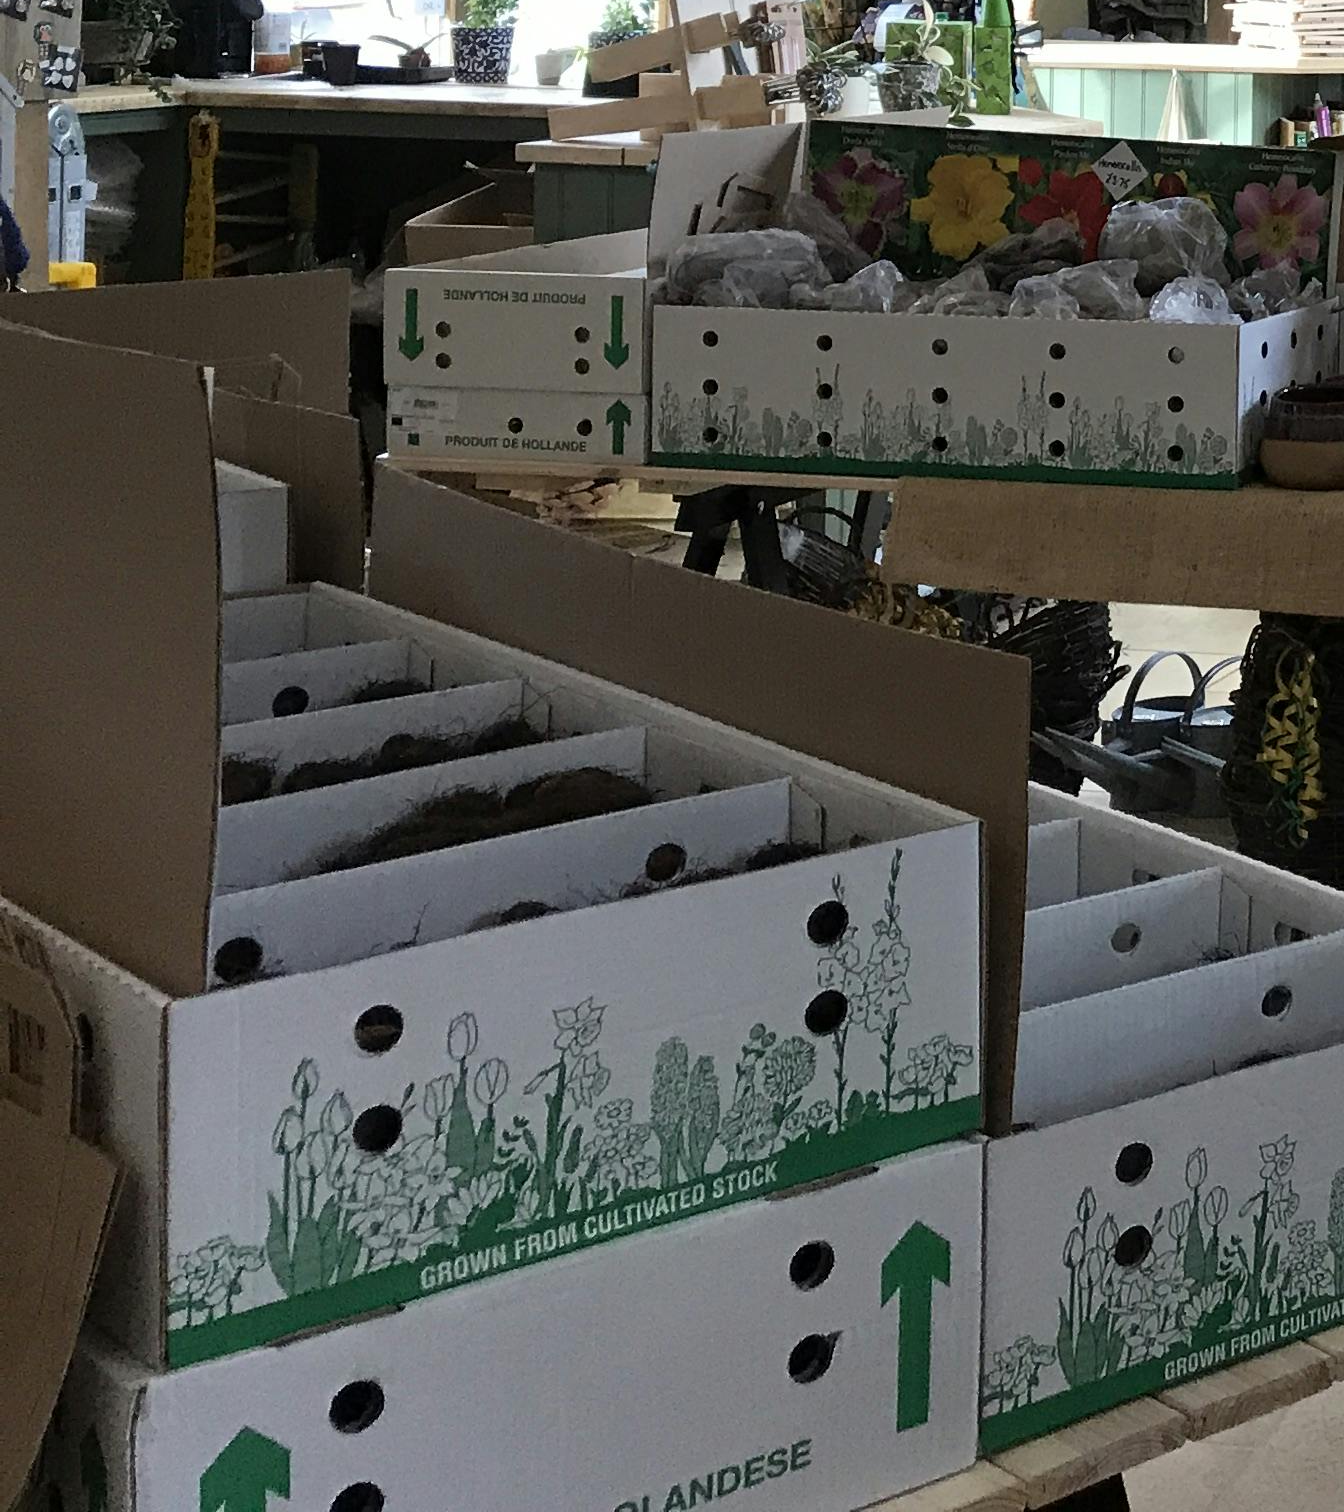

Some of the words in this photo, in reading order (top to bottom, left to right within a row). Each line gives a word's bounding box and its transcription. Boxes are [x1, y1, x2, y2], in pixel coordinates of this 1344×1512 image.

[443, 288, 508, 304] HOLLANDE
[511, 291, 529, 303] DE
[531, 292, 587, 305] PRODUIT
[445, 435, 499, 448] PRODUIT
[502, 437, 518, 449] DE
[521, 438, 587, 452] HOLLANDE
[420, 1243, 508, 1292] GROWN
[511, 1220, 579, 1267] FROM
[583, 1183, 706, 1245] CULTIVATED
[711, 1160, 779, 1207] STOCK
[1164, 1342, 1227, 1382] GROWN
[1229, 1323, 1277, 1362] FROM
